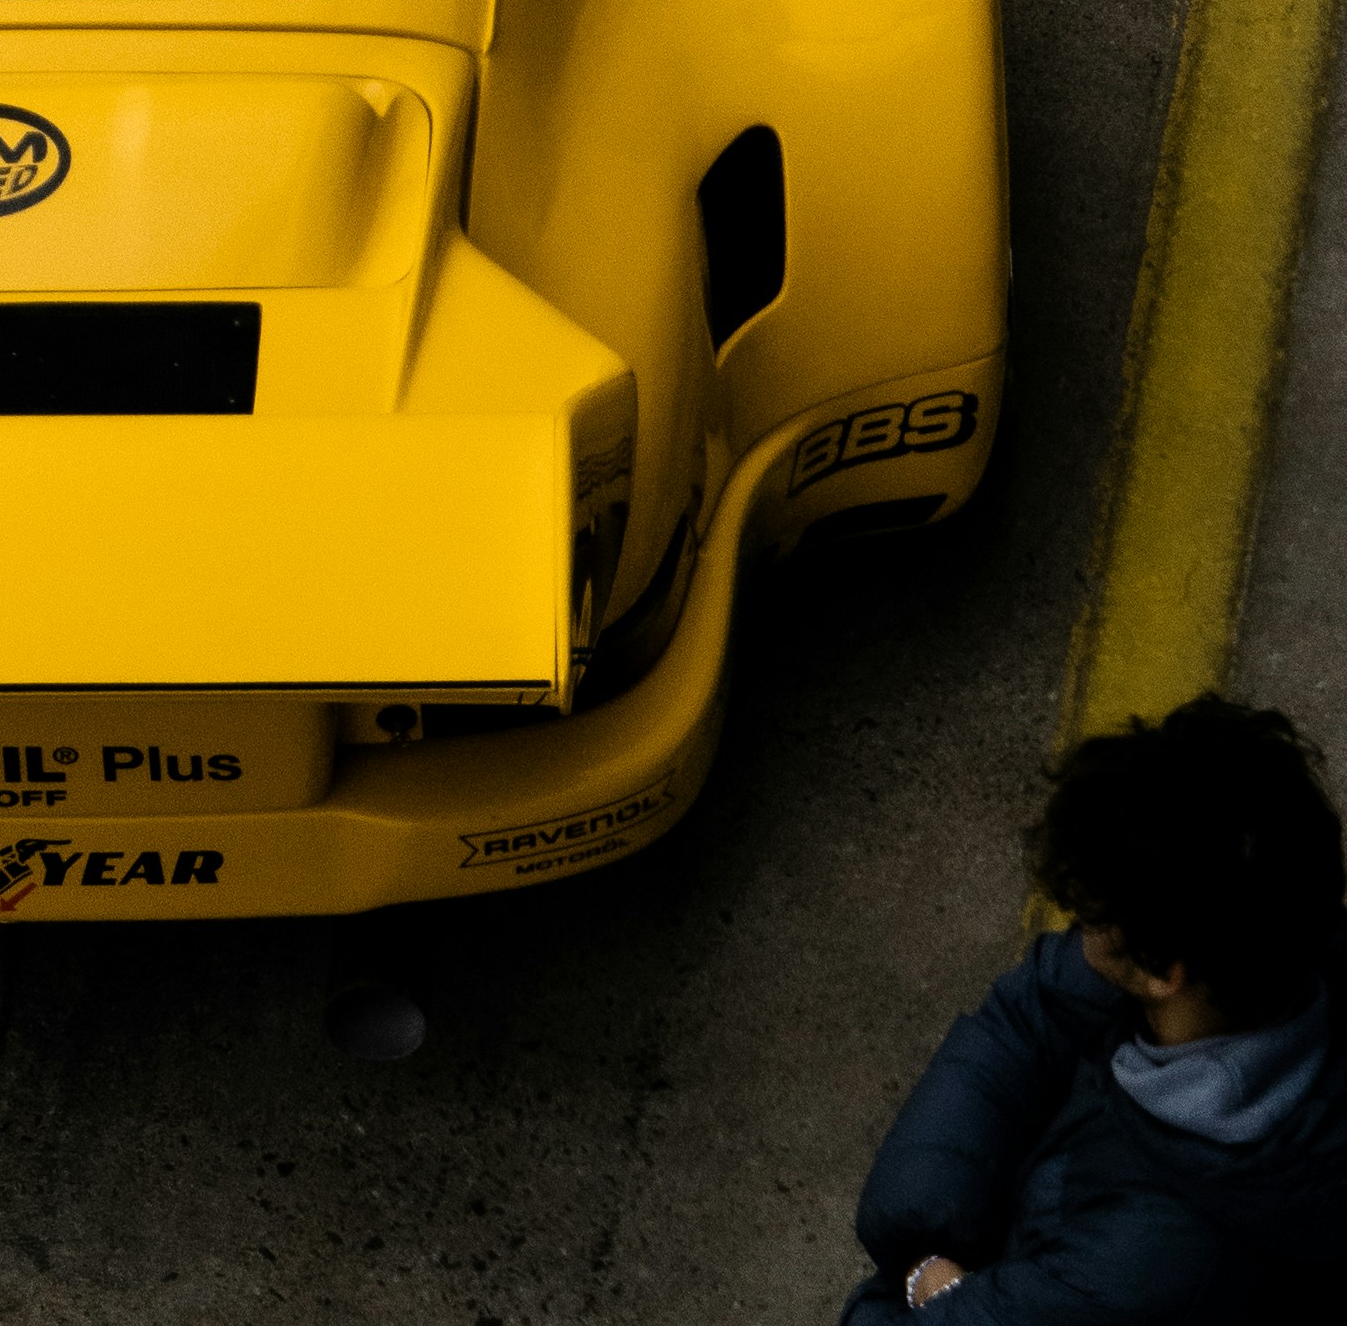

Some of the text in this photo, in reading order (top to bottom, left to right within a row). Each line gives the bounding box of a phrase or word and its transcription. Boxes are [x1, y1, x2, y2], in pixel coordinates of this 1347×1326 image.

[787, 390, 979, 499] BBS
[102, 746, 242, 782] Plus
[483, 791, 662, 857] RAVENOL
